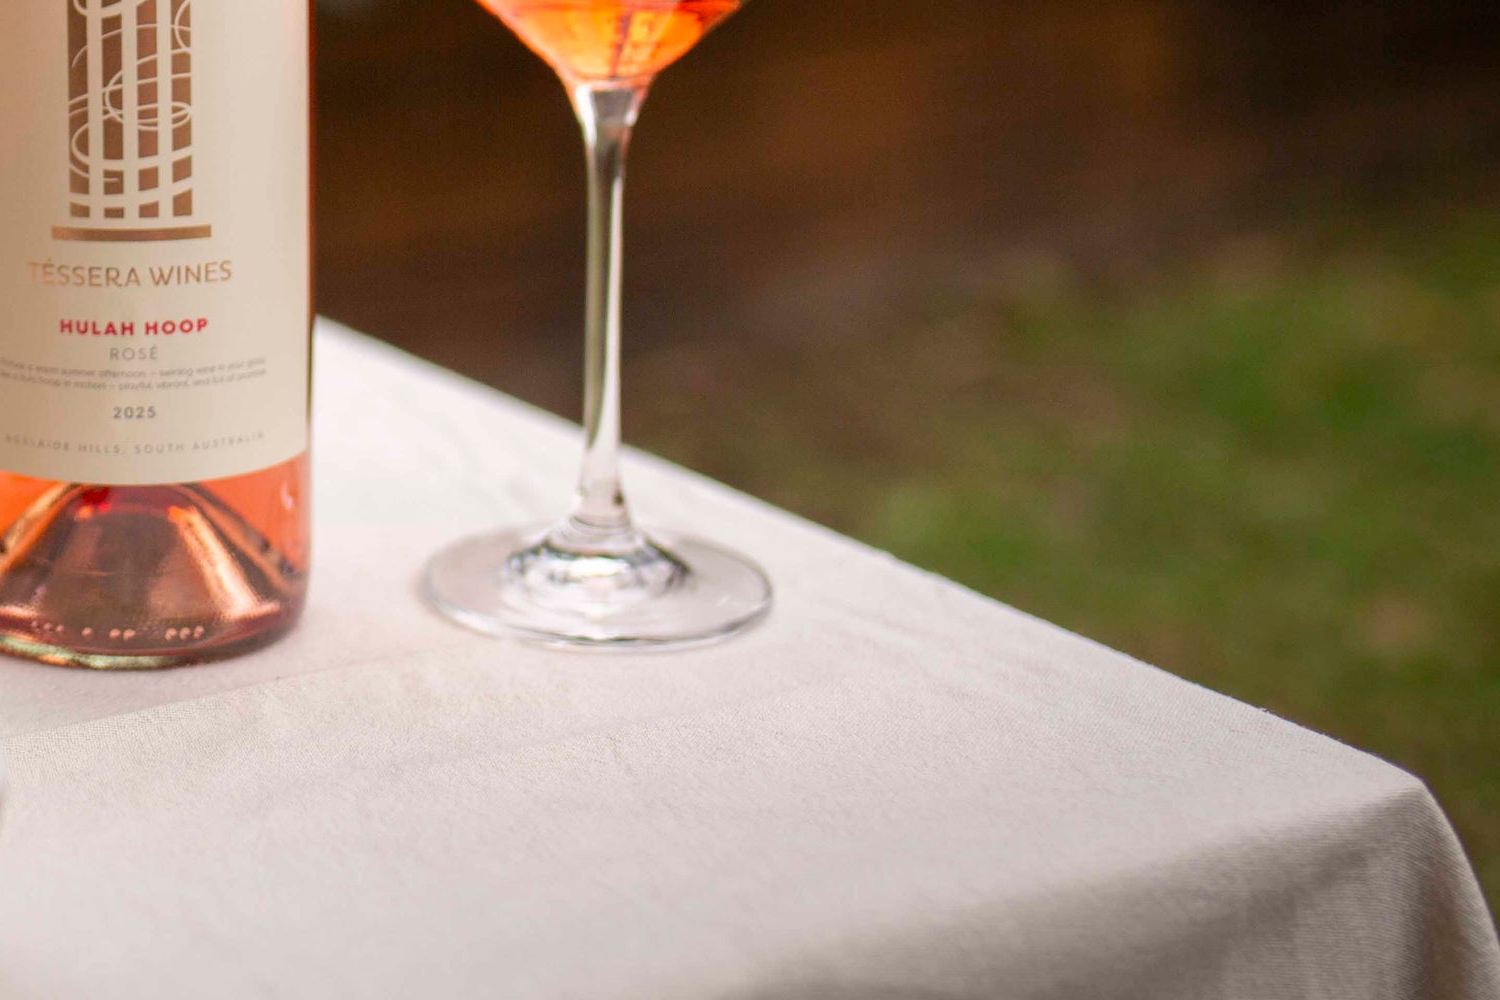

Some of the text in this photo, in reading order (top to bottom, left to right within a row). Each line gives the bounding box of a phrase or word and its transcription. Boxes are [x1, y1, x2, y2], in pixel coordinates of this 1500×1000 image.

[28, 258, 233, 288] TÉSSERA WINES
[59, 317, 209, 336] HULAH HOOP
[109, 344, 158, 361] ROSÉ
[112, 405, 157, 420] 2025
